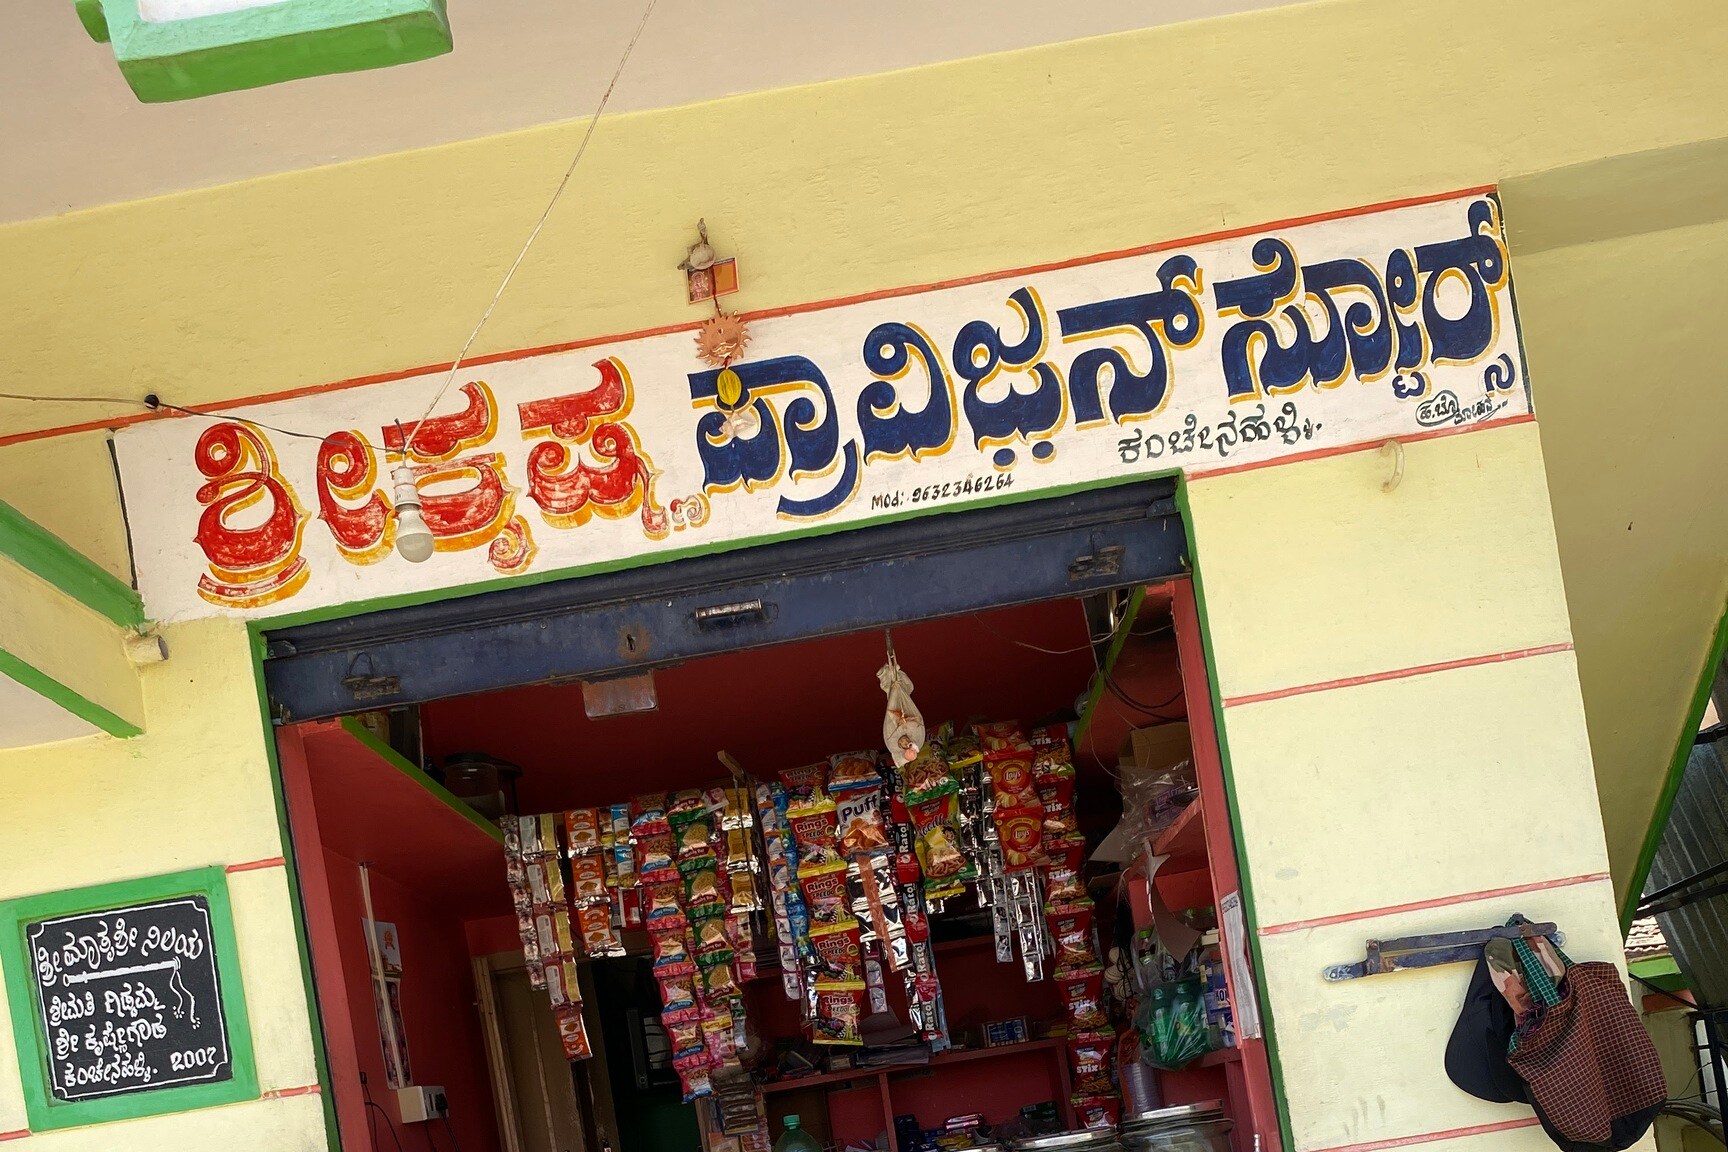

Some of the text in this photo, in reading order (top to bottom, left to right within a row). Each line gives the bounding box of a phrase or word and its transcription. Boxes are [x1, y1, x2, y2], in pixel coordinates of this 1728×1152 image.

[841, 793, 878, 822] Puff
[796, 818, 828, 833] Rings
[899, 823, 909, 853] Ratol
[806, 878, 839, 893] Rings
[905, 883, 918, 914] Ratol
[38, 947, 63, 986] ಶ್ರೀ
[141, 925, 204, 960] ನಿಲಯ
[818, 936, 850, 950] Rings
[916, 942, 927, 973] Ratol
[50, 991, 96, 1026] ಶ್ರೀಮತಿ
[925, 1001, 936, 1030] Ratol
[56, 1028, 79, 1060] ಶ್ರೀ
[170, 1046, 217, 1072] 2007
